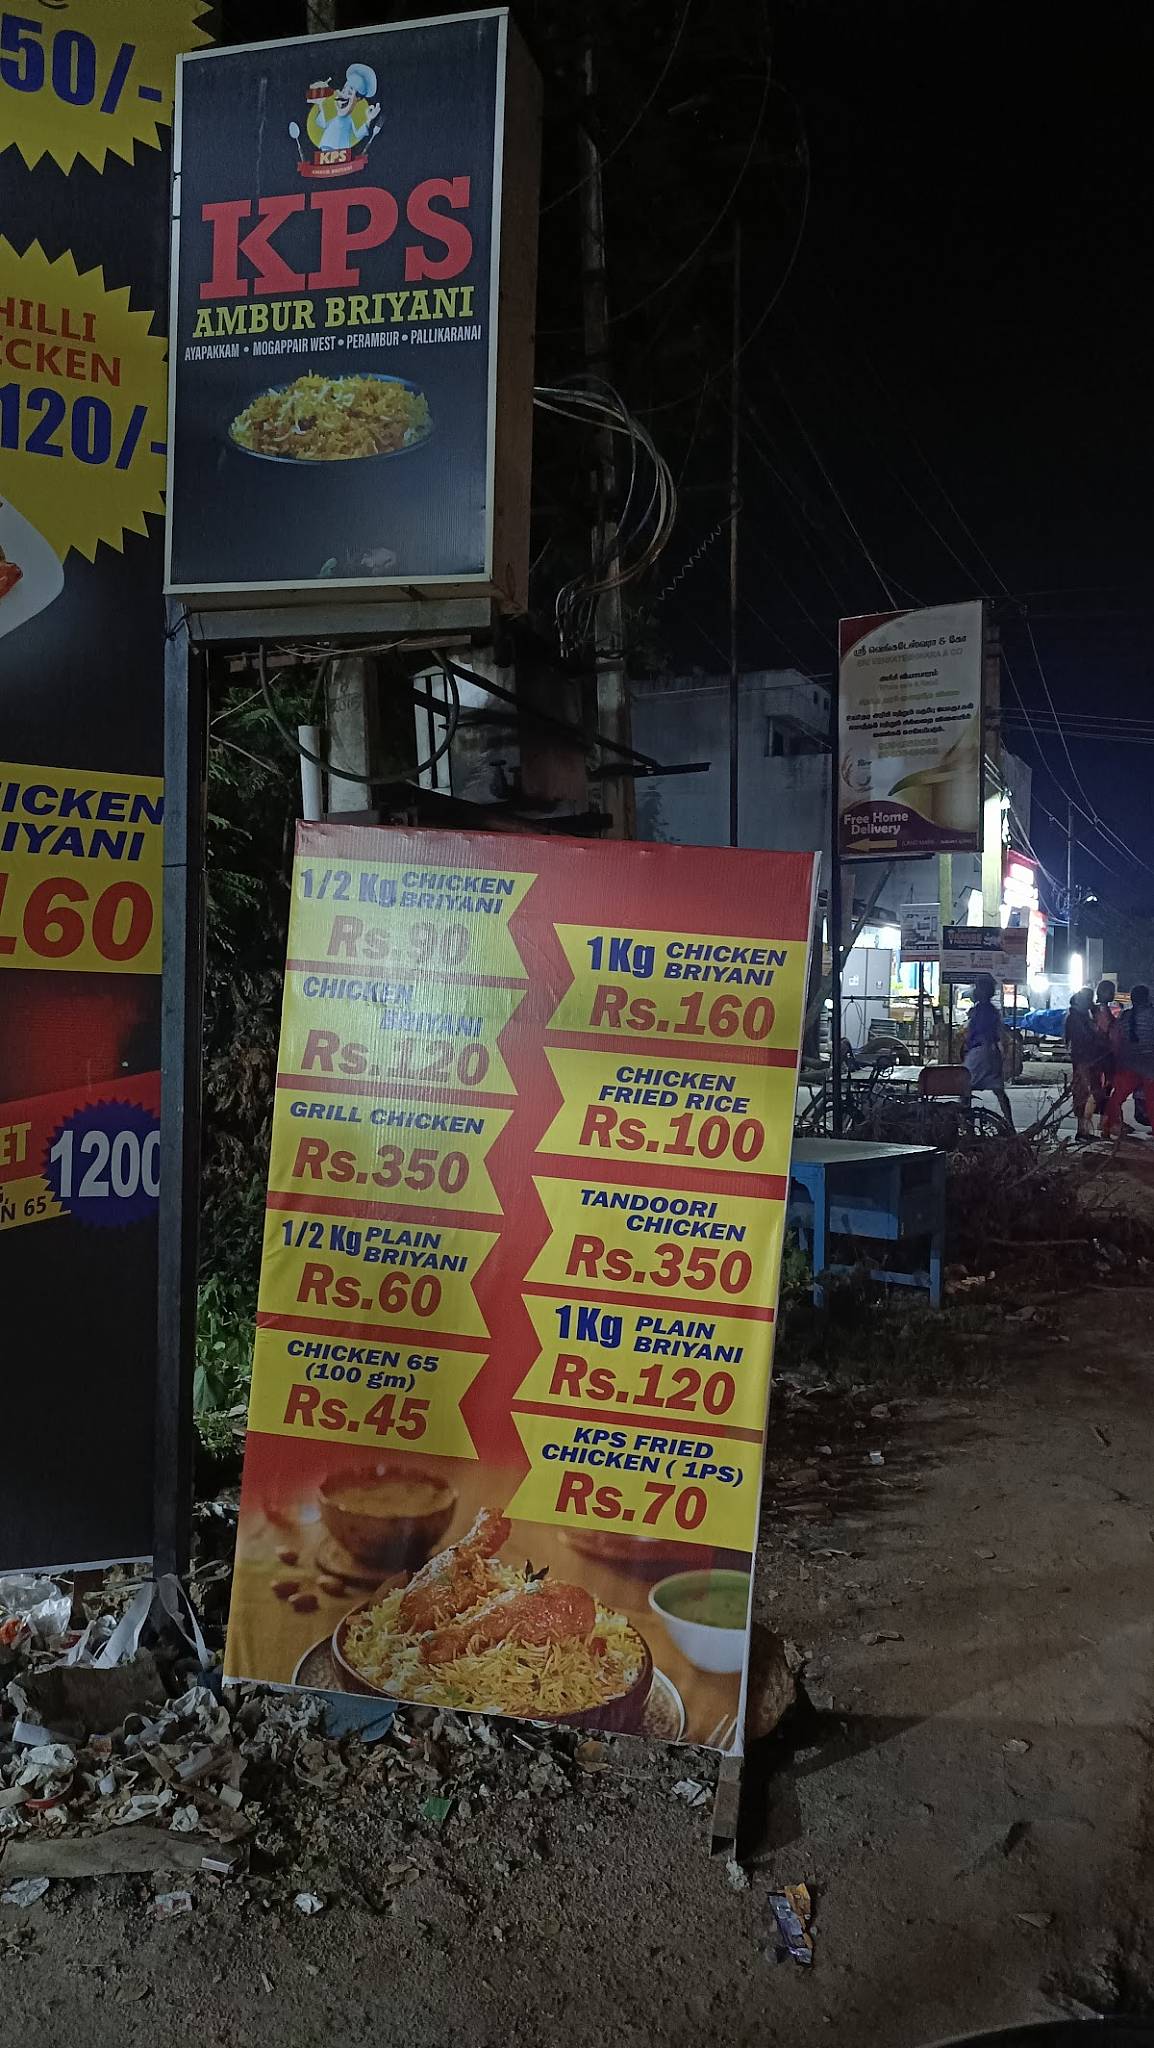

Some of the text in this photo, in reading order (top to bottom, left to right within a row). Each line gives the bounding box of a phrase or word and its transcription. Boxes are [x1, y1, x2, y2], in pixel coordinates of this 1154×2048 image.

[320, 150, 347, 165] KPS
[200, 176, 473, 299] KPS
[192, 286, 475, 338] AMBUR BRIYANI
[184, 325, 482, 361] AYAPAKKAM MOGAPPAIR WEST PERAMBUR PALLIKARANAI
[0, 336, 121, 387] CKEN
[0, 782, 165, 825] ICKEN
[843, 812, 909, 825] Free Home
[851, 823, 901, 835] Delivery
[300, 868, 516, 909] 1/2 Kg CHICKEN
[399, 891, 504, 915] BRIYANI
[0, 873, 154, 962] 60
[326, 915, 470, 967] Rs.90
[665, 941, 788, 967] CHICKEN
[302, 975, 415, 1006] CHICKEN
[664, 962, 776, 987] BRIYANI
[379, 1009, 484, 1038] BRIYANI
[588, 984, 776, 1041] Rs.160
[300, 1029, 491, 1086] Rs.120
[615, 1066, 737, 1092] CHICKEN
[598, 1085, 751, 1115] FRIED RICE
[290, 1101, 485, 1136] GRILL CHICKEN
[578, 1104, 766, 1163] Rs.100
[50, 1130, 160, 1198] 1200
[291, 1136, 470, 1195] Rs.350
[23, 1195, 47, 1217] 65
[580, 1188, 719, 1219] TANDOORI
[281, 1219, 442, 1257] 1/2 Kg PLAIN
[625, 1214, 747, 1242] CHICKEN
[362, 1248, 469, 1273] BRIYANI
[564, 1233, 753, 1295] Rs.350
[295, 1262, 443, 1318] Rs.60
[634, 1315, 716, 1341] PLAIN
[286, 1339, 440, 1373] CHICKEN 65
[633, 1336, 744, 1364] BRIYANI
[304, 1361, 417, 1393] (100 gm)
[548, 1353, 737, 1417] Rs.120
[282, 1383, 432, 1441] Rs.45
[541, 1443, 661, 1474] CHICKEN
[572, 1426, 715, 1459] KPS FRIED
[554, 1470, 709, 1531] Rs.70
